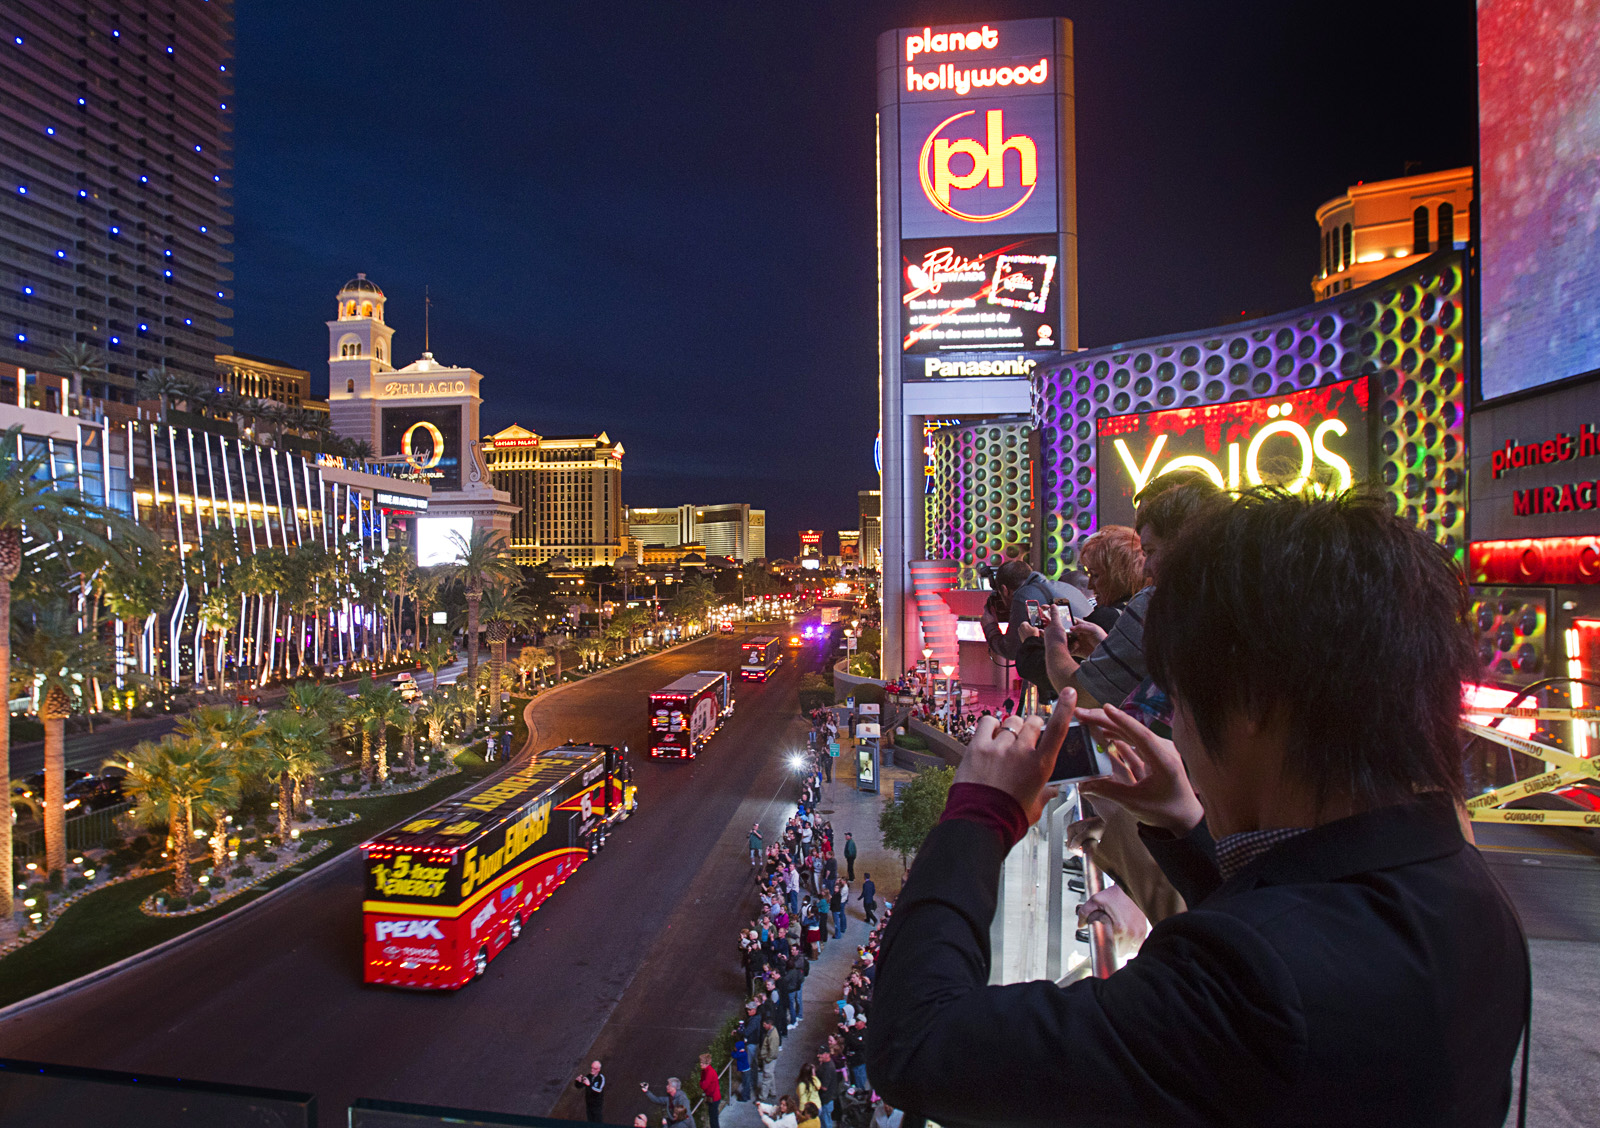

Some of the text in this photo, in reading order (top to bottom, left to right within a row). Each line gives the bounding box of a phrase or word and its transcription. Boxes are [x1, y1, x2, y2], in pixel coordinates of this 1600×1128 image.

[906, 25, 999, 62] planet
[906, 58, 1048, 95] hollywood
[933, 109, 1038, 207] ph
[924, 356, 1037, 377] Panasonic
[383, 380, 466, 397] BELLAGIO
[1492, 424, 1600, 479] planet h
[1513, 480, 1600, 516] MIRAC
[1503, 811, 1545, 823] CUIDADO
[375, 919, 446, 941] PEAK
